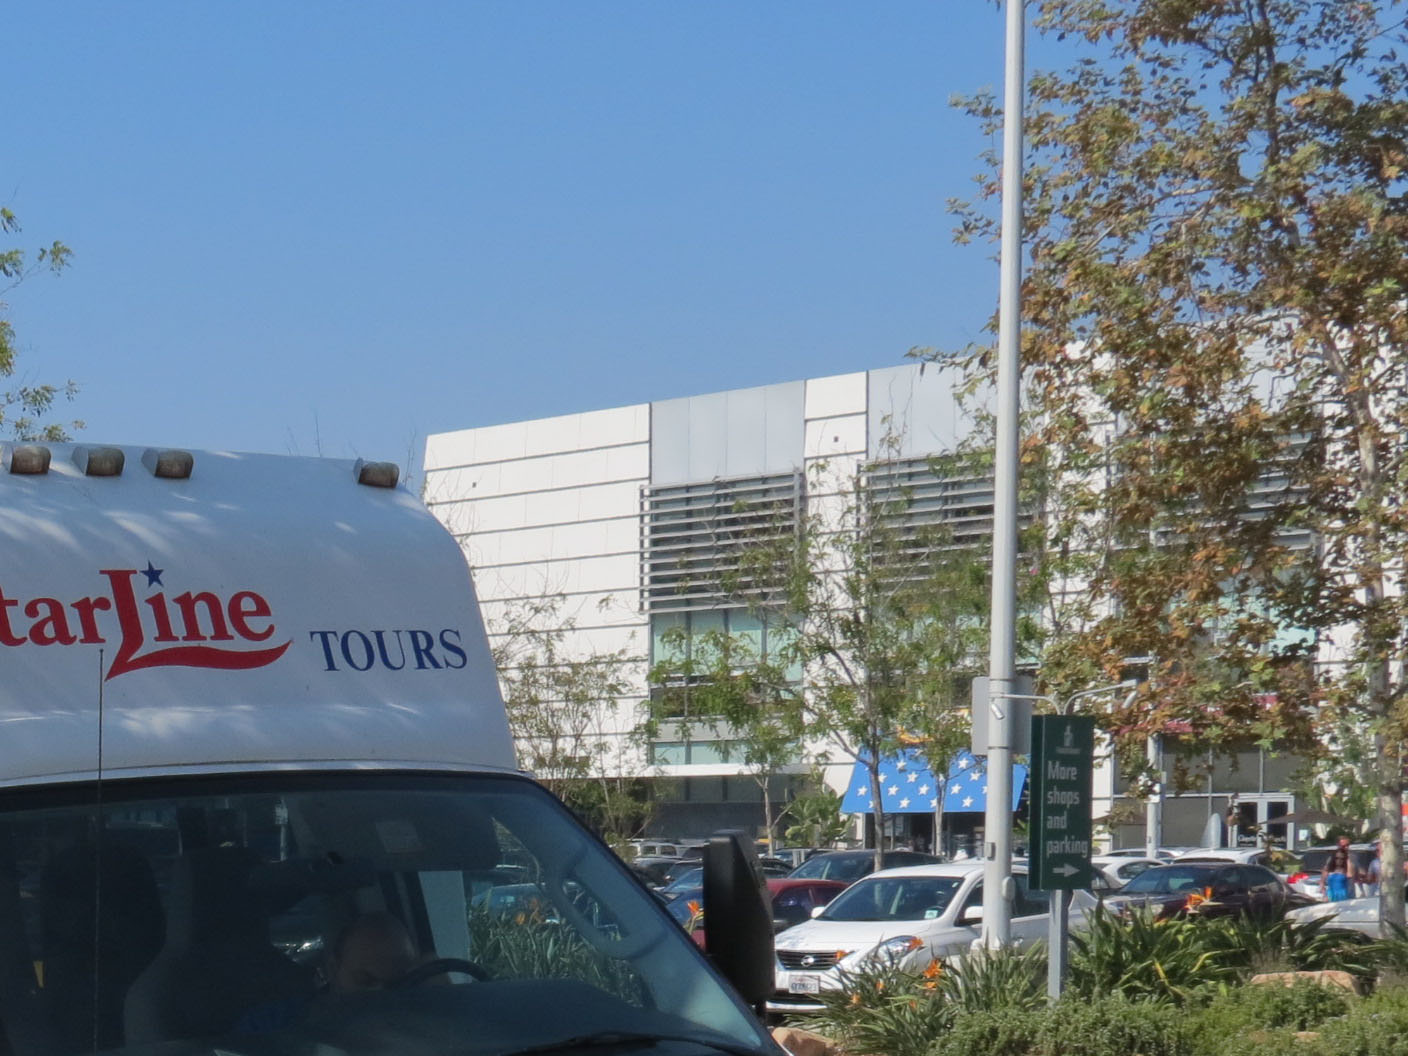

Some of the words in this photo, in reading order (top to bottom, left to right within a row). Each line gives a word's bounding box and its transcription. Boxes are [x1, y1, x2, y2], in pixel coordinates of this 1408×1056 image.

[310, 629, 468, 672] TOURS
[1048, 761, 1078, 780] More
[1047, 786, 1080, 808] shops
[1047, 811, 1067, 829] and
[1046, 835, 1088, 858] parking
